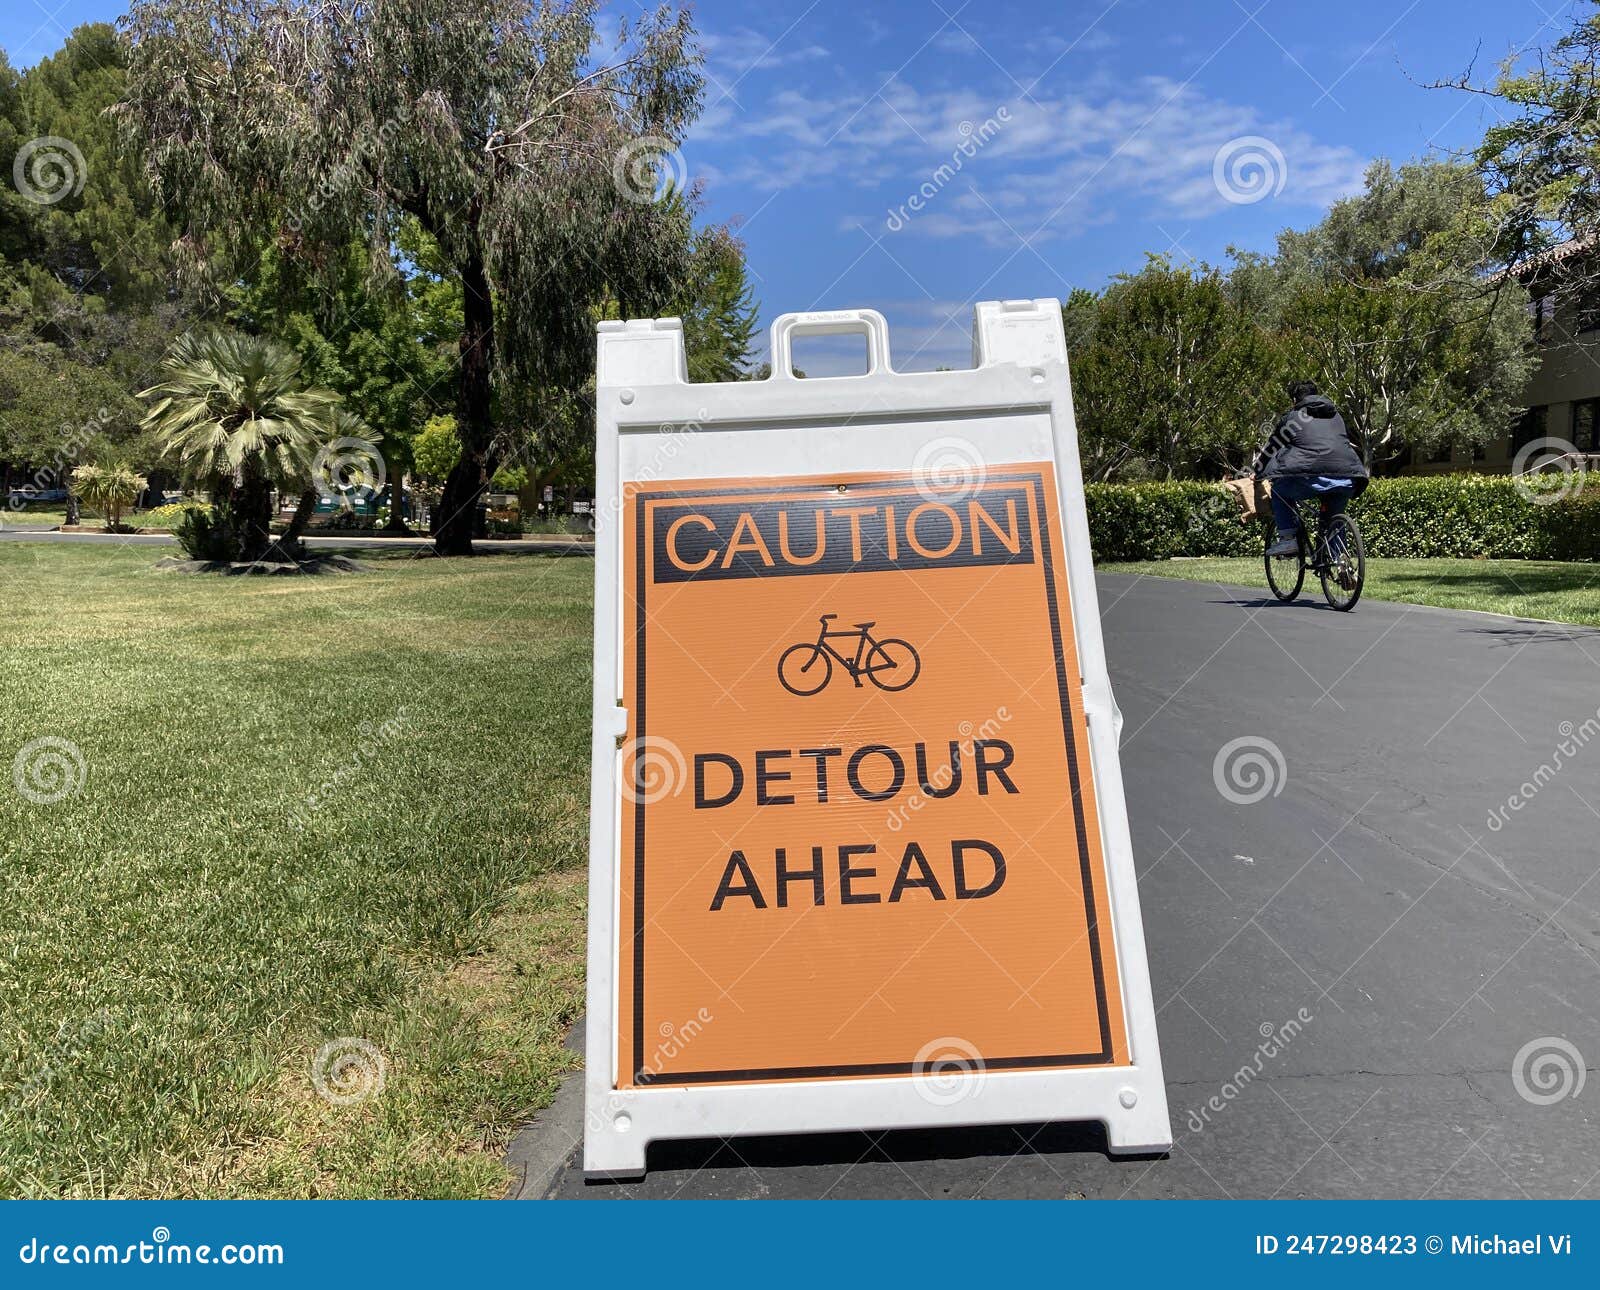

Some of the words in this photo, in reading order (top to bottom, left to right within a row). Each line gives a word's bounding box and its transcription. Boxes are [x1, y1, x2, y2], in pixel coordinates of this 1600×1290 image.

[665, 499, 1021, 571] CAUTION
[694, 738, 1020, 809] DETOUR
[709, 839, 1007, 911] AHEAD
